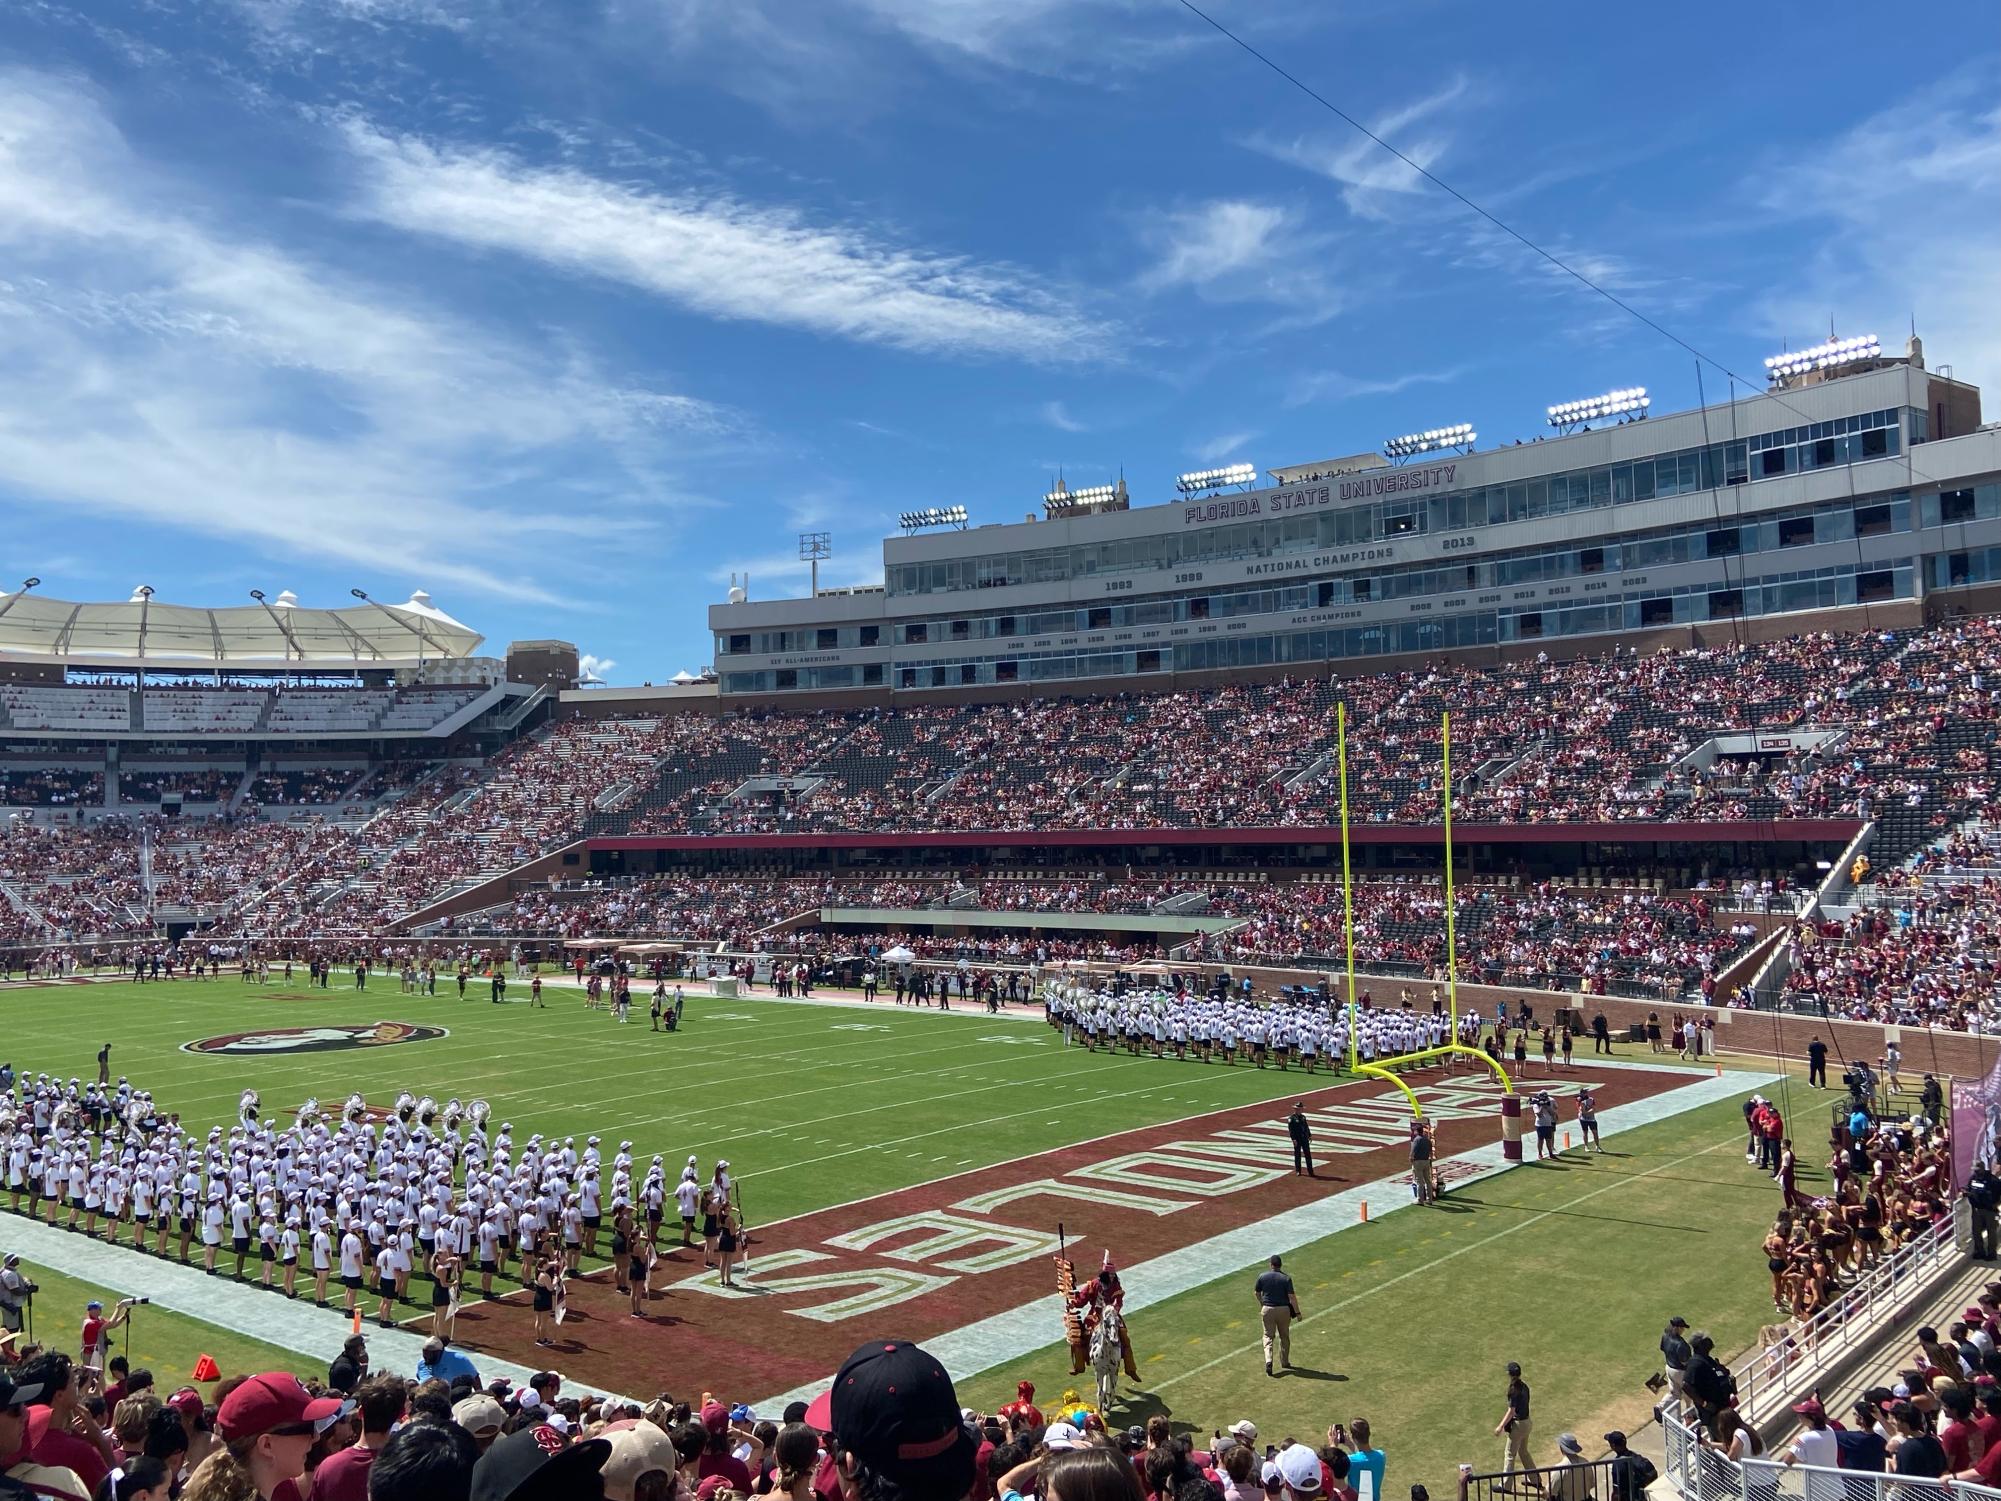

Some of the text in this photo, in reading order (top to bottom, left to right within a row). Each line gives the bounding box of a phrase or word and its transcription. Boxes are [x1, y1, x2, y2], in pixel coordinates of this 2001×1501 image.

[1185, 464, 1457, 524] FLORIDA STATE UNIVERSITY
[1246, 557, 1309, 575] NATIONAL
[1313, 547, 1394, 568] CHAMPIONS
[1442, 536, 1475, 550] 2013
[1291, 616, 1308, 624] ACC
[1311, 610, 1362, 622] CHAMPIONS
[660, 1073, 1606, 1323] SEMINOLES
